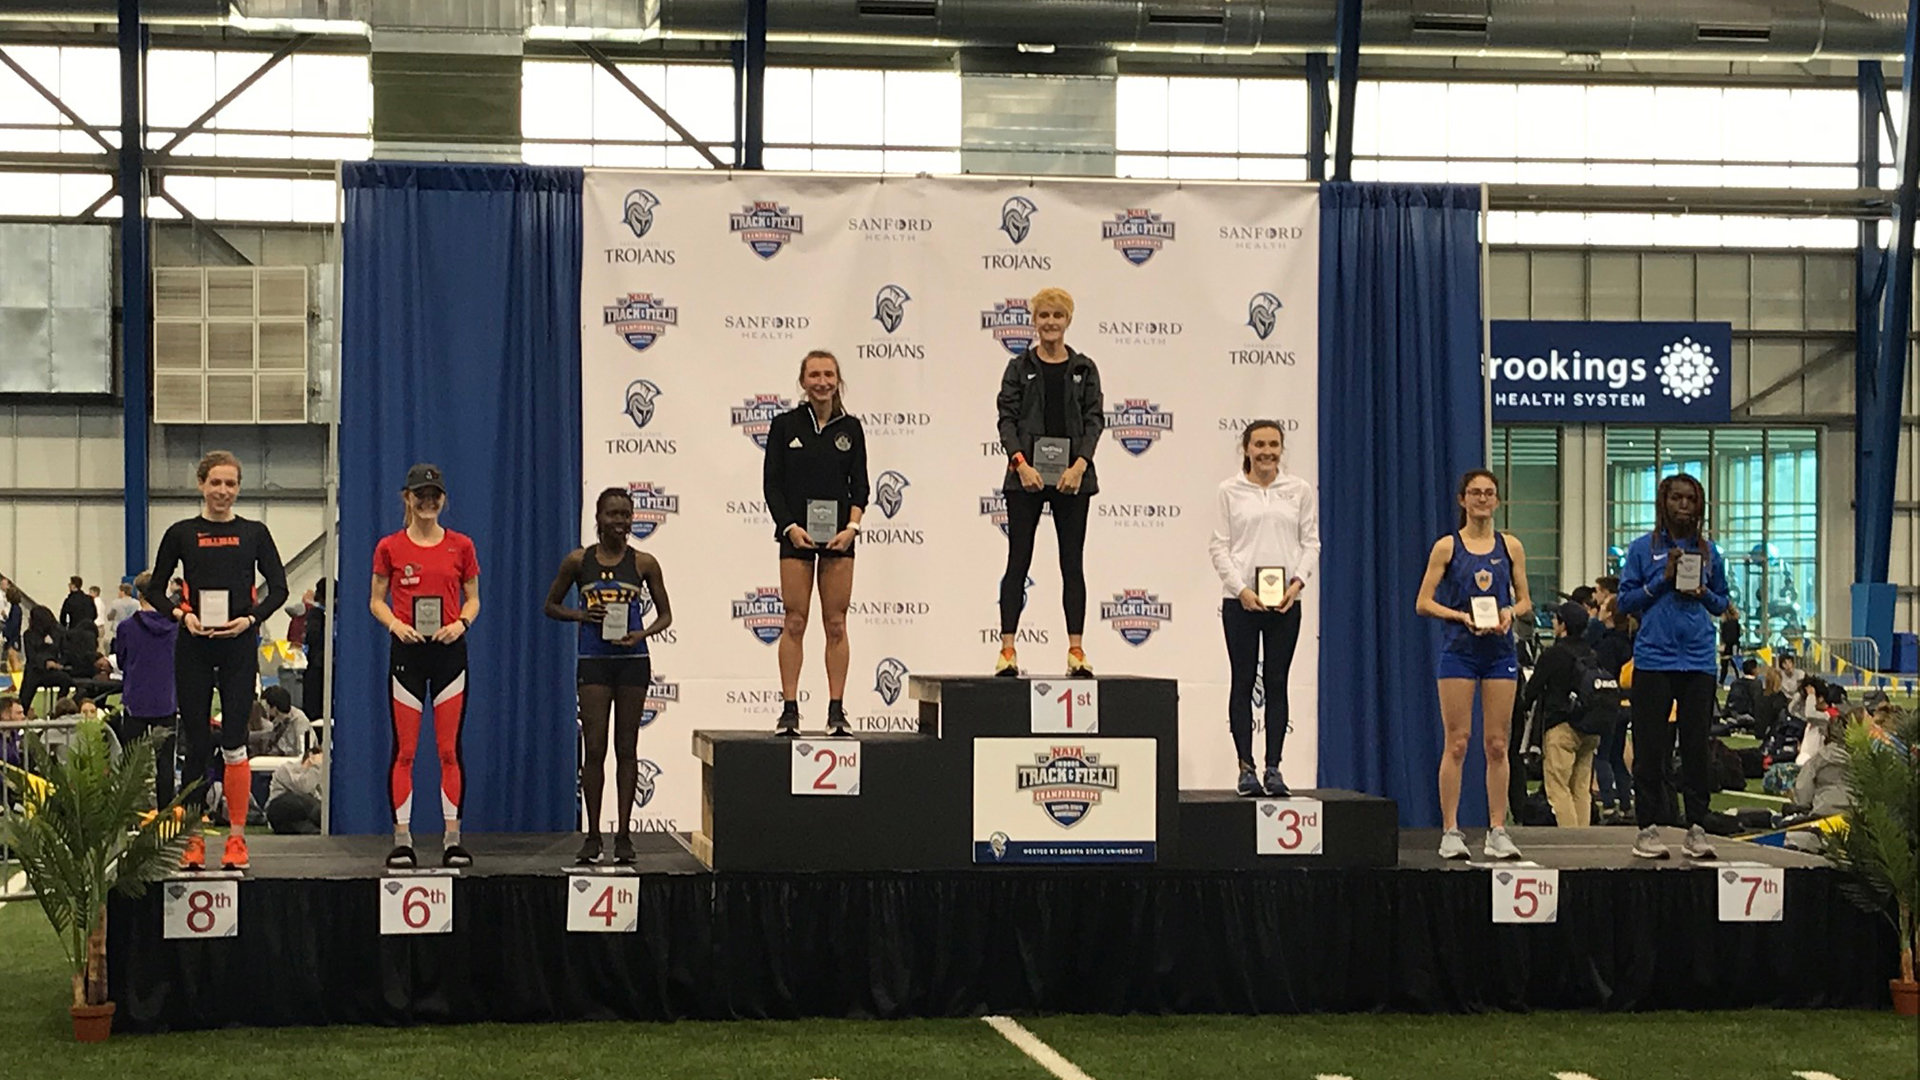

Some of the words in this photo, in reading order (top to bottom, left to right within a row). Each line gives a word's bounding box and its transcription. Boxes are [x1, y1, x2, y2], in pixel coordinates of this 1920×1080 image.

[849, 217, 932, 231] SANFORD
[1219, 226, 1303, 239] SANFORD
[605, 248, 675, 265] TROJANS
[983, 254, 1052, 270] TROJANS
[605, 308, 640, 322] TRACK
[725, 316, 810, 329] SANFORD
[983, 313, 1017, 327] TRACK
[1099, 322, 1183, 335] SANFORD
[856, 343, 925, 359] TROJANS
[1229, 350, 1295, 366] TROJANS
[1490, 349, 1647, 389] rookings
[1495, 393, 1566, 406] HEALTH
[1573, 393, 1646, 406] SYSTEM
[853, 413, 931, 426] ANFORD
[605, 438, 676, 454] TROJANS
[1098, 505, 1181, 518] SANFORD
[734, 602, 768, 616] TRACK
[849, 601, 930, 615] SANFORD
[726, 690, 811, 703] SANFOD
[1057, 688, 1091, 729] 1st
[1052, 747, 1083, 759] NAIA
[813, 749, 857, 790] 2nd
[1019, 767, 1067, 787] TRACK
[1074, 767, 1116, 788] FIELD
[1277, 809, 1317, 850] 3rd
[1513, 878, 1553, 918] 5th
[1740, 876, 1778, 916] 7th
[186, 890, 232, 933] 8th
[402, 886, 447, 929] 6th
[589, 885, 633, 927] 4th
